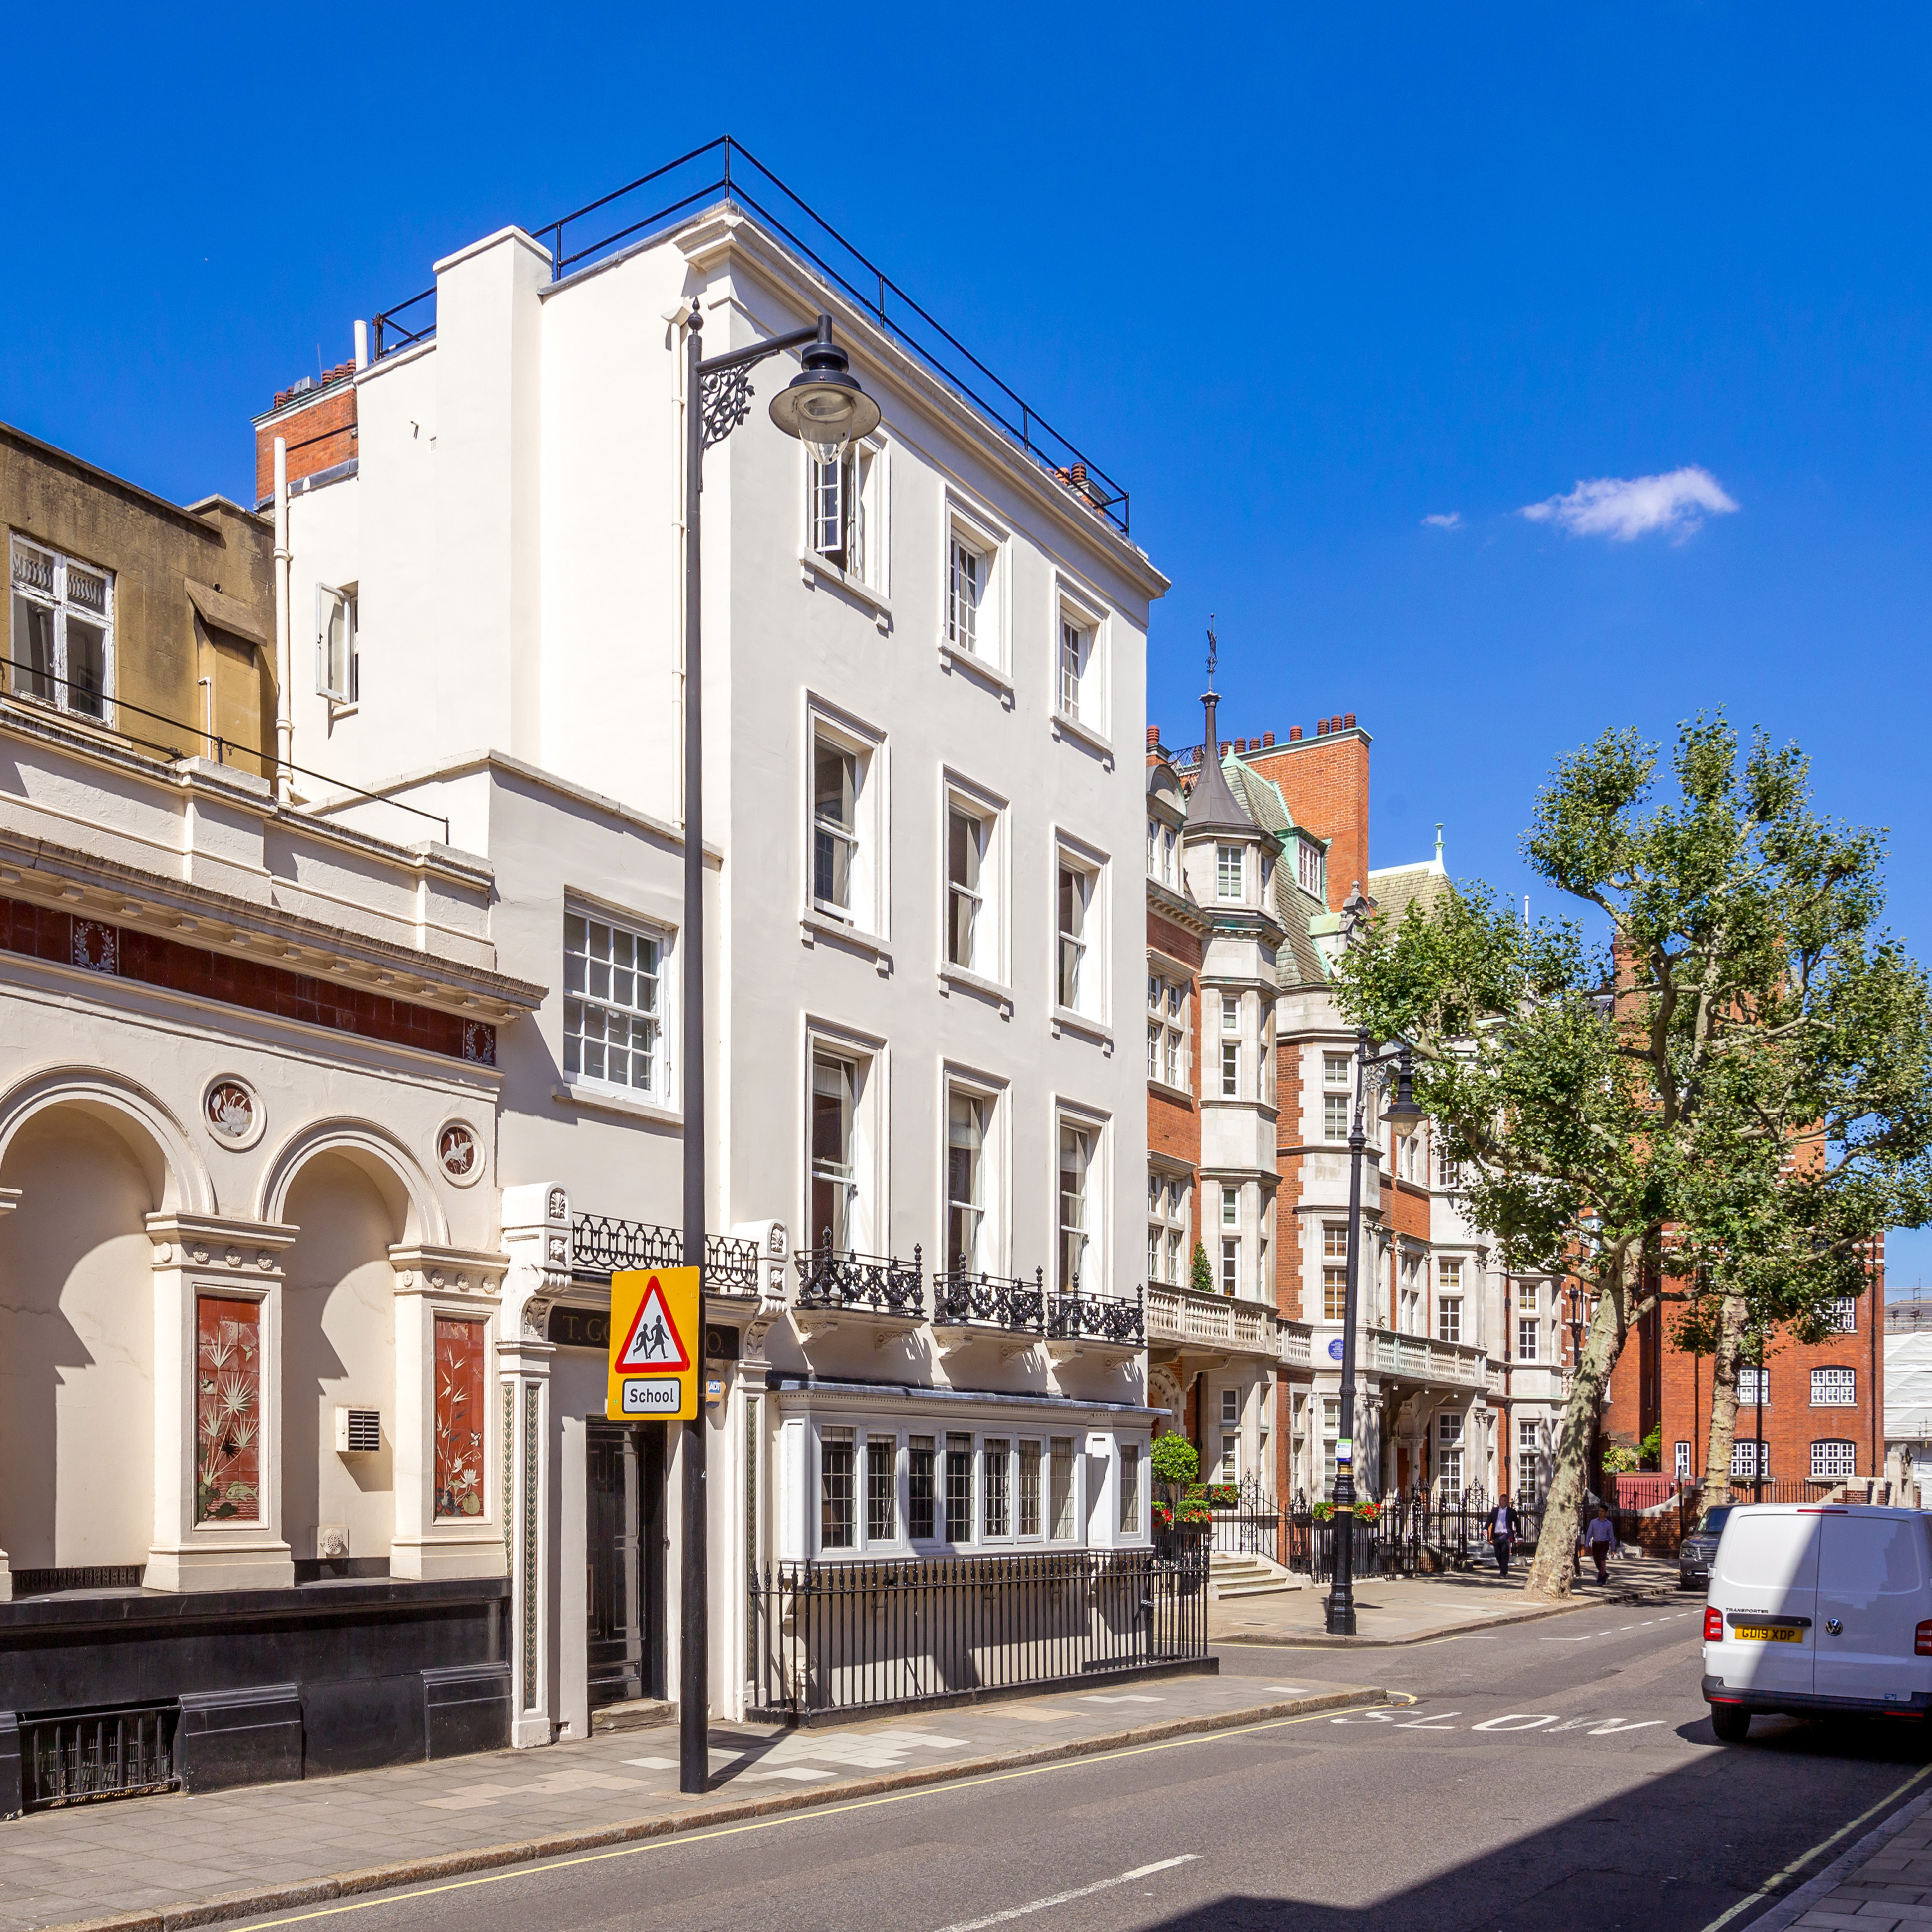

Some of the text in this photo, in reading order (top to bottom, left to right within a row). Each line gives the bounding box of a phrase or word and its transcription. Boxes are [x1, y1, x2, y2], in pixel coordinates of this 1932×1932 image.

[709, 1382, 721, 1391] ADT
[630, 1388, 674, 1403] School
[1742, 1627, 1795, 1640] GD19 XDP
[1330, 1710, 1668, 1735] SLOW
